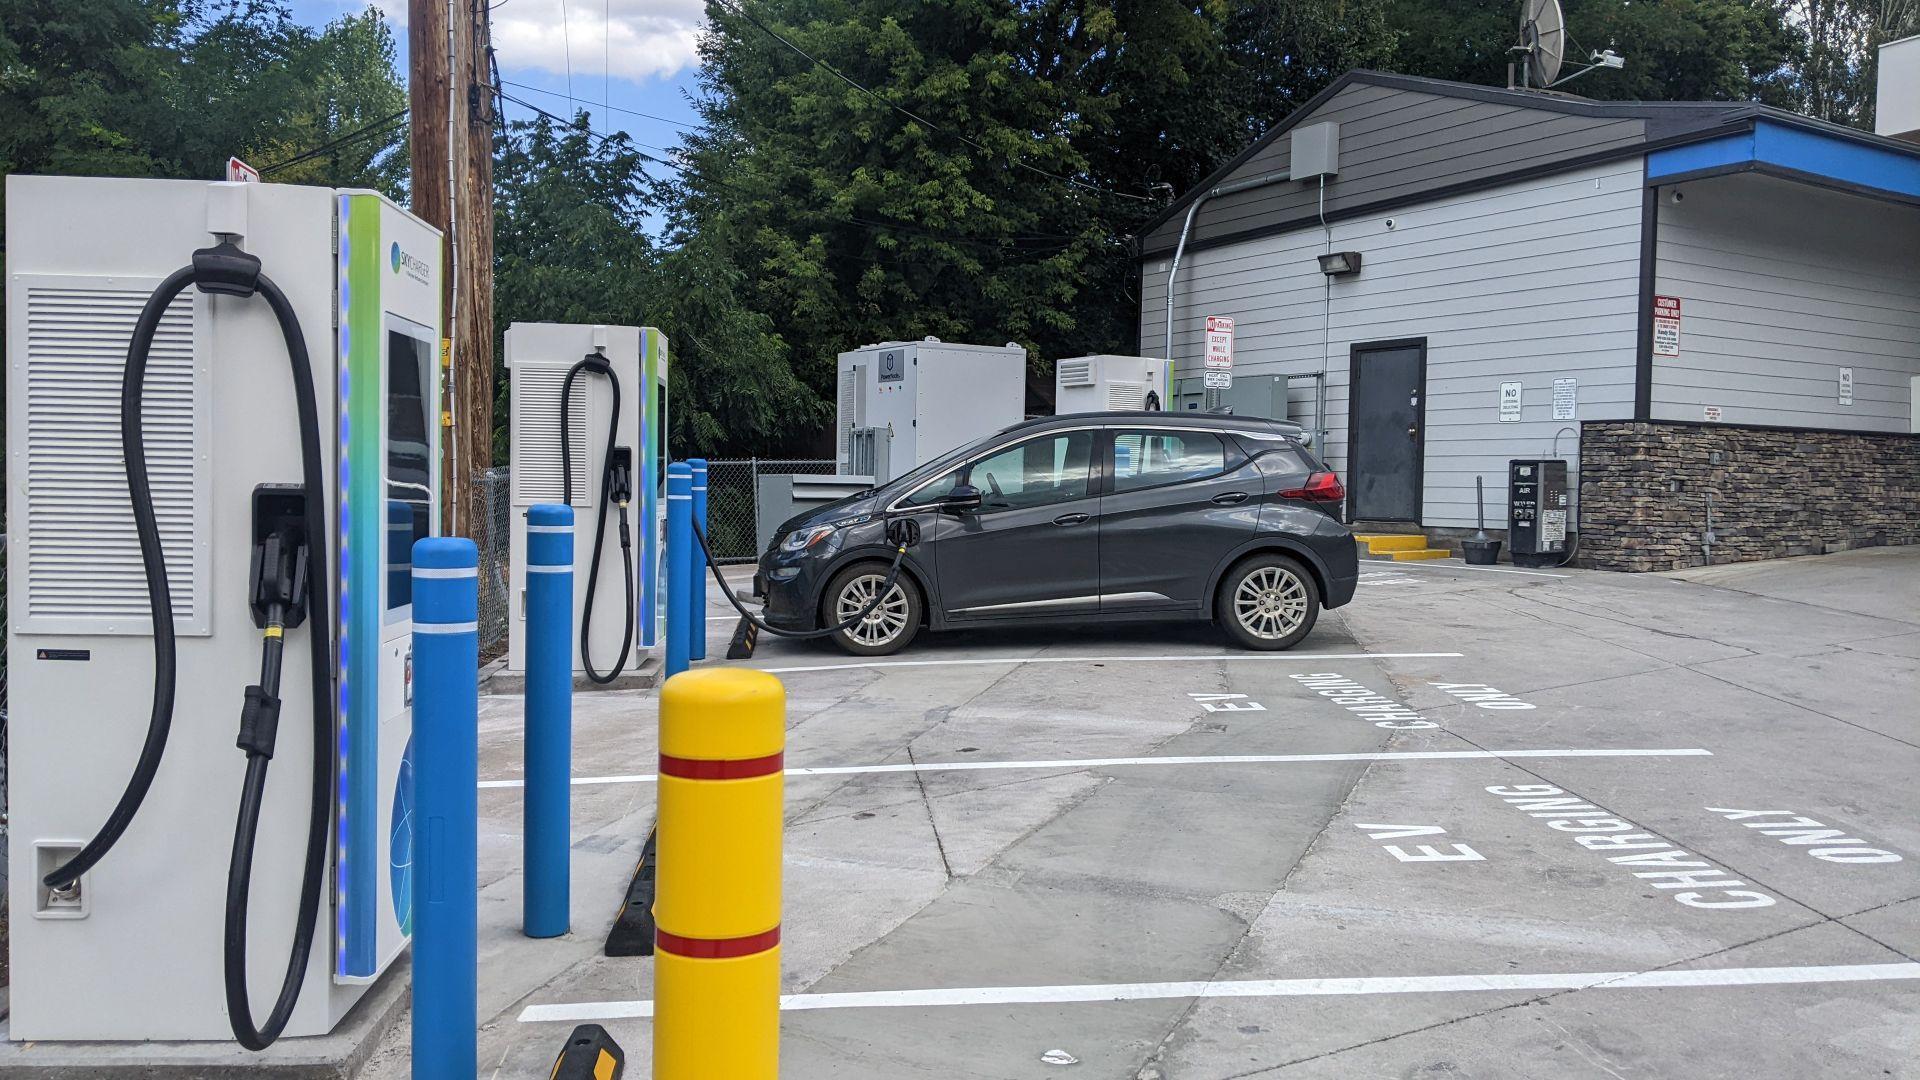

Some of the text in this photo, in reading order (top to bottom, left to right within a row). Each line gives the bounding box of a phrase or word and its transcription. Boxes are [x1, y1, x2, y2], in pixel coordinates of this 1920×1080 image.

[1654, 307, 1670, 316] PARKING
[1657, 298, 1677, 308] CUSTOMER
[1208, 354, 1230, 363] CHARGING
[1212, 345, 1226, 353] WHILE
[1505, 389, 1517, 397] NO
[1187, 693, 1267, 713] EV
[1289, 673, 1439, 730] CHARGING
[1427, 682, 1537, 710] ONLY
[1354, 822, 1487, 863] EV
[1704, 806, 1903, 864] ONLY
[1485, 784, 1777, 909] CHARGING
